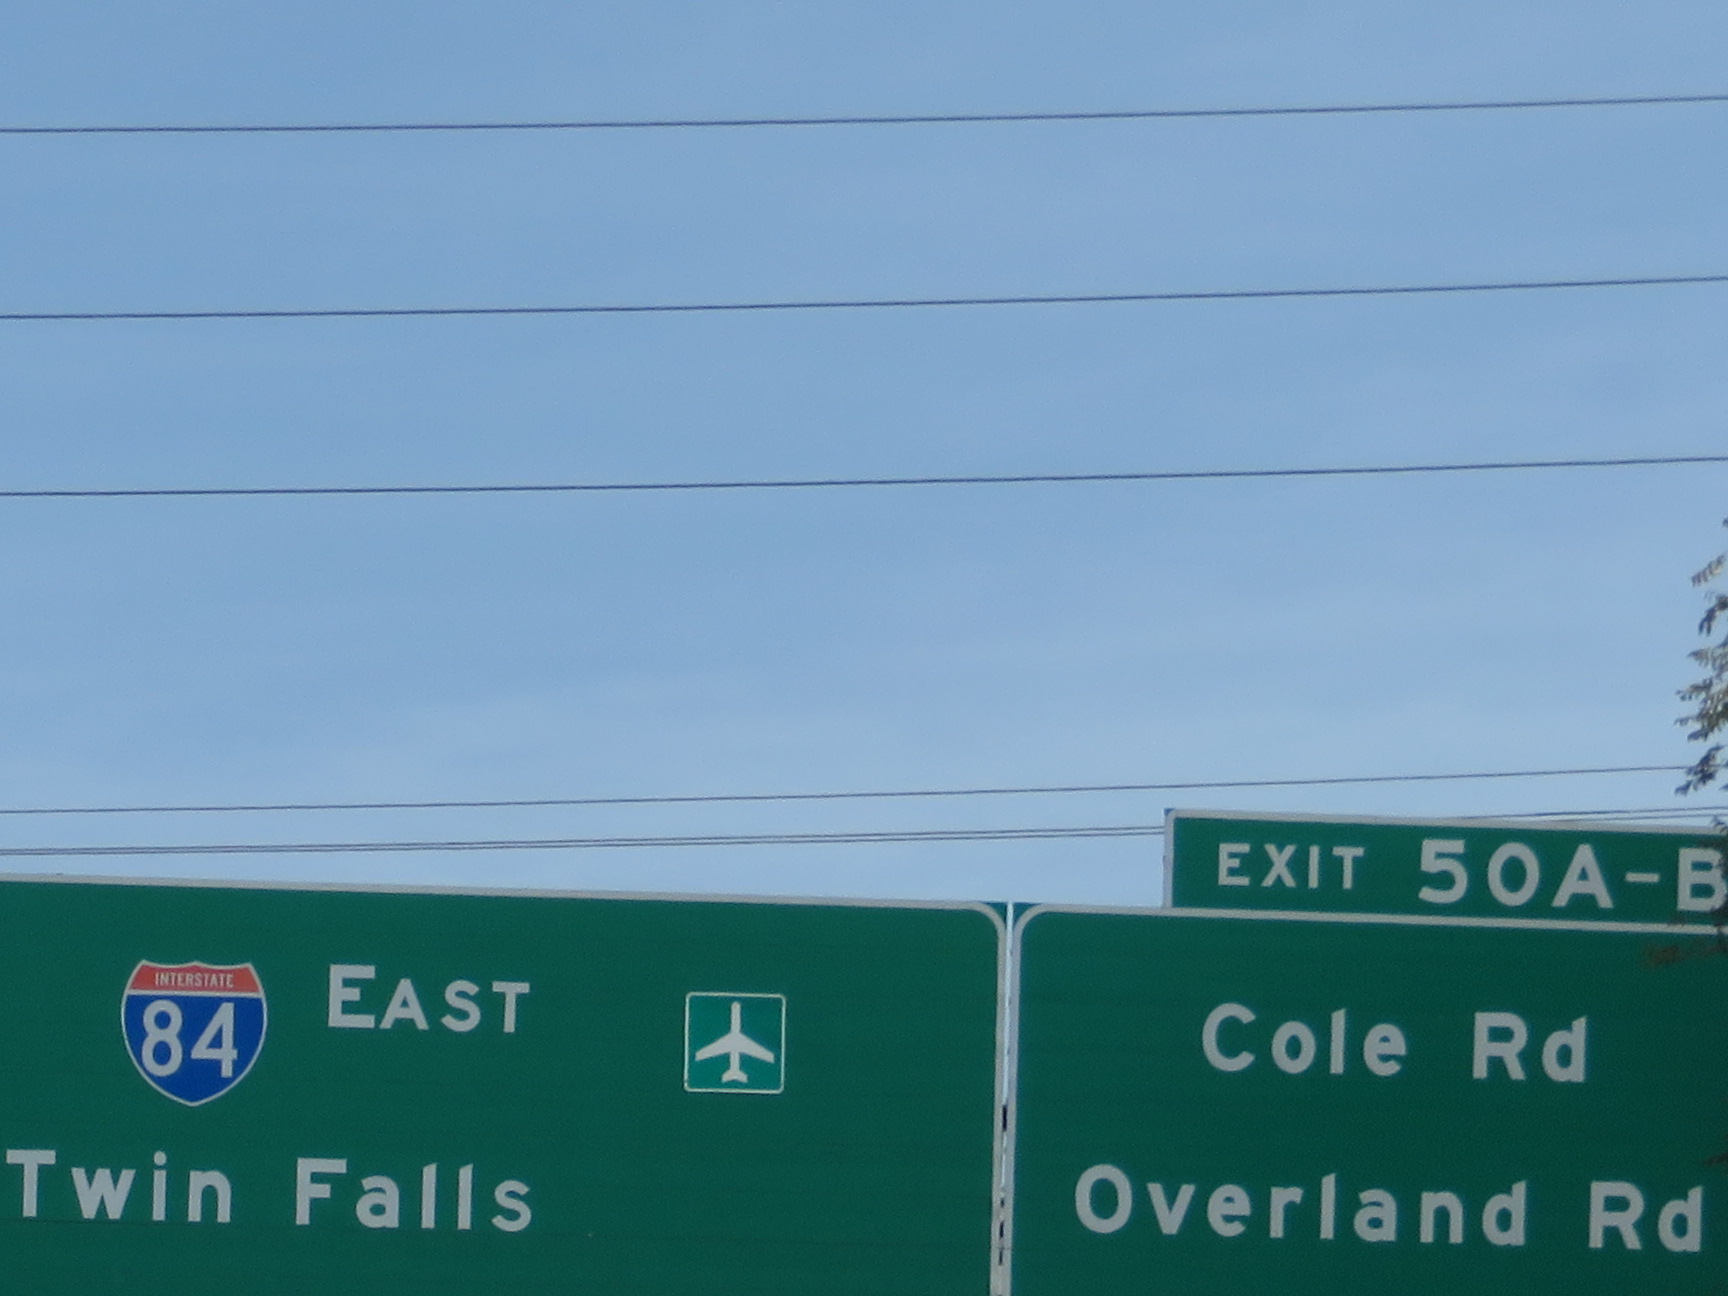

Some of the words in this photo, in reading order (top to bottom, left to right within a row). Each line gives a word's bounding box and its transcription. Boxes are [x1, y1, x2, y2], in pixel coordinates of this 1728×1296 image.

[1218, 842, 1365, 890] EXIT
[1418, 838, 1727, 912] 50A-B
[154, 968, 235, 990] INTERSTATE
[327, 964, 531, 1033] EAST
[142, 999, 239, 1079] 84
[1202, 1002, 1407, 1077] Cole
[1472, 1011, 1588, 1083] Rd
[6, 1148, 232, 1223] Twin
[295, 1157, 533, 1232] Falls
[1074, 1163, 1527, 1246] Overland
[1588, 1180, 1704, 1253] Rd
